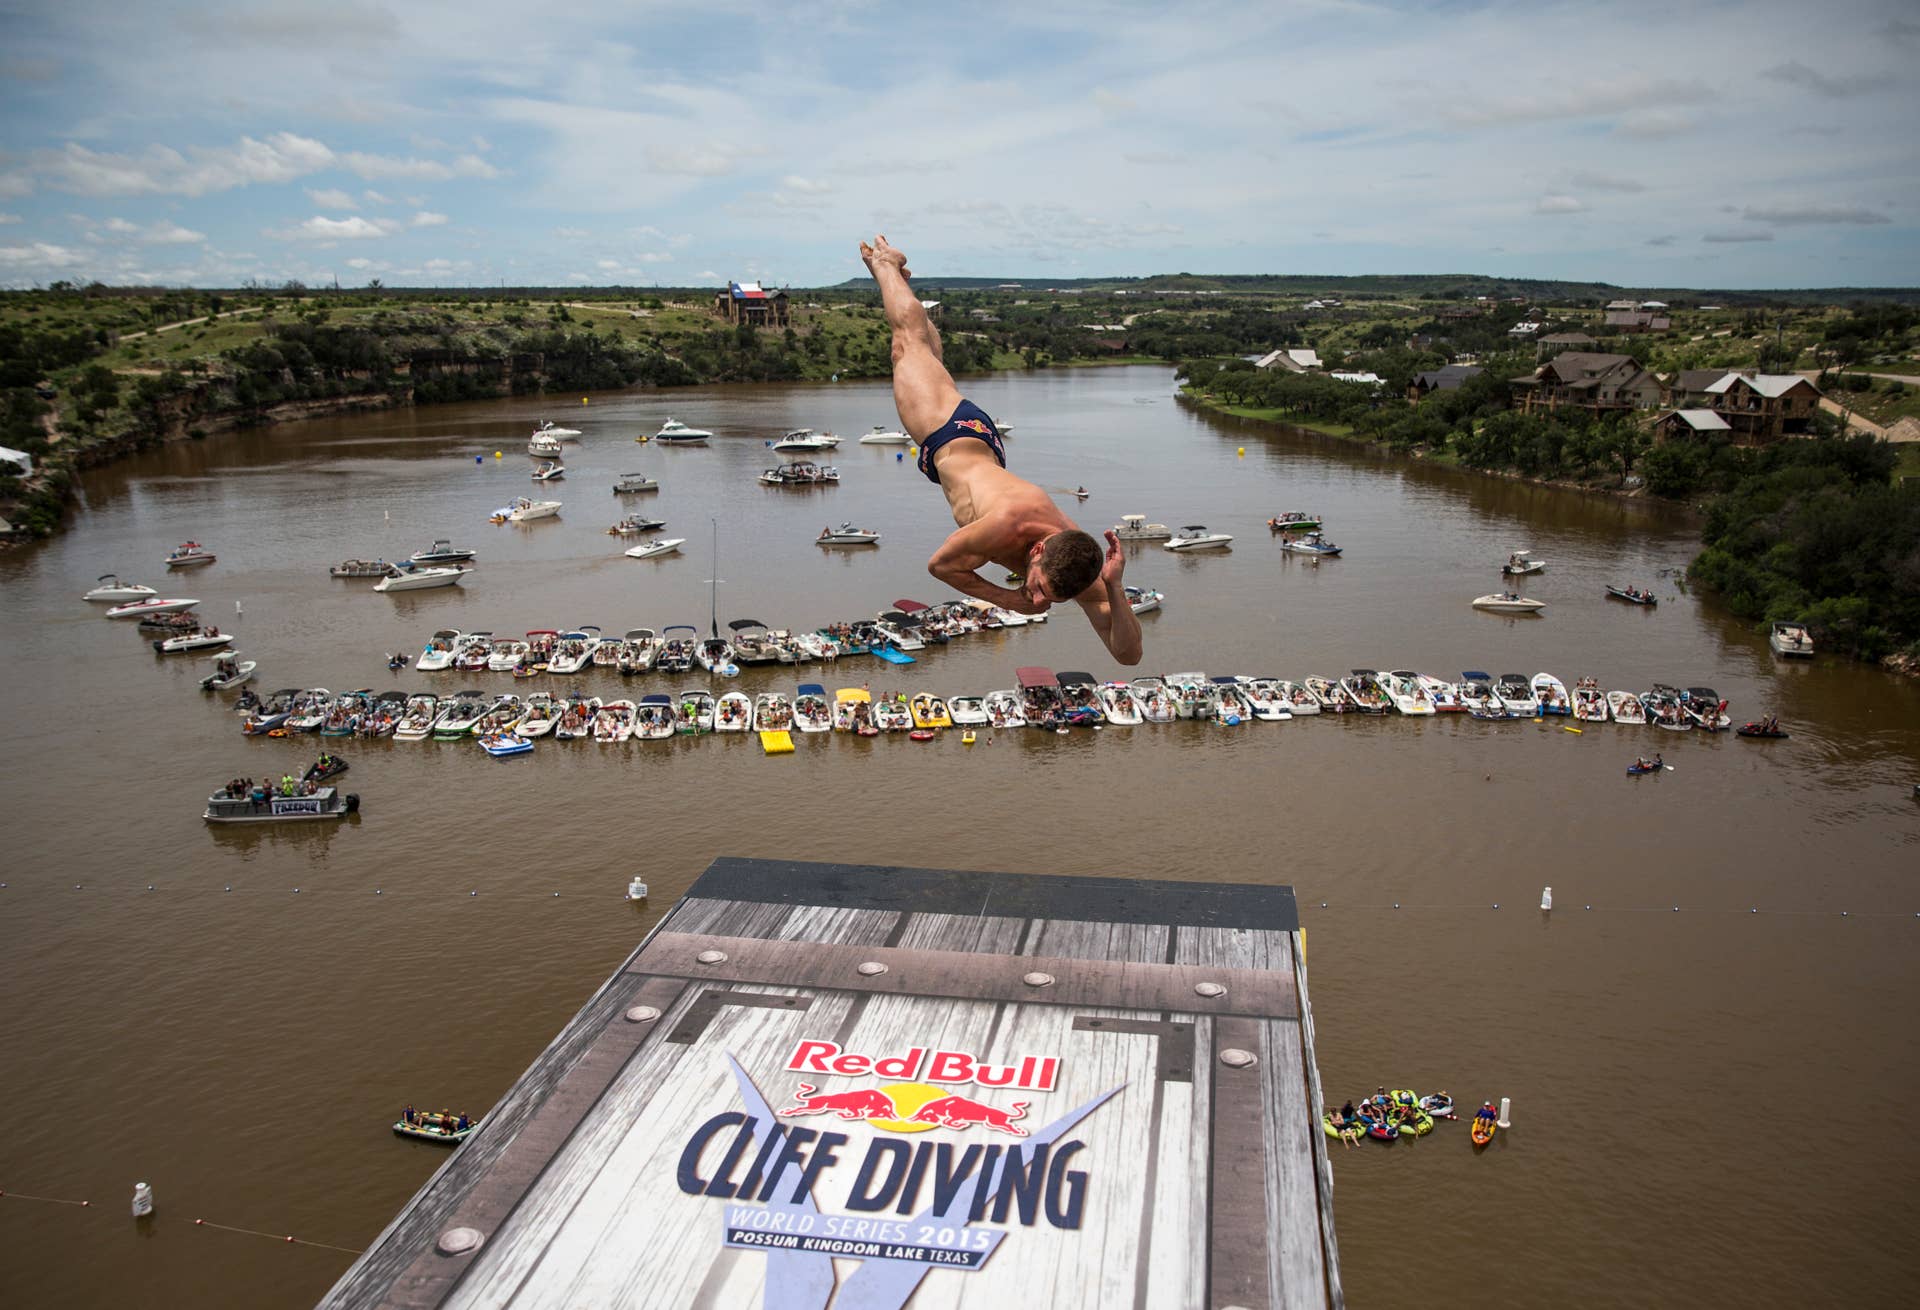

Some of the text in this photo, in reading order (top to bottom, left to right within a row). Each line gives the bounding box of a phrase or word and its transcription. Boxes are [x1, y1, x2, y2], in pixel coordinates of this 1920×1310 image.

[789, 1041, 1056, 1089] Red Bull
[677, 1112, 1087, 1230] CLIFF DIVING
[730, 1208, 991, 1250] WORLD SERIES 2015
[733, 1231, 970, 1265] POSSUM KINGDOM LAKE TEXAS
